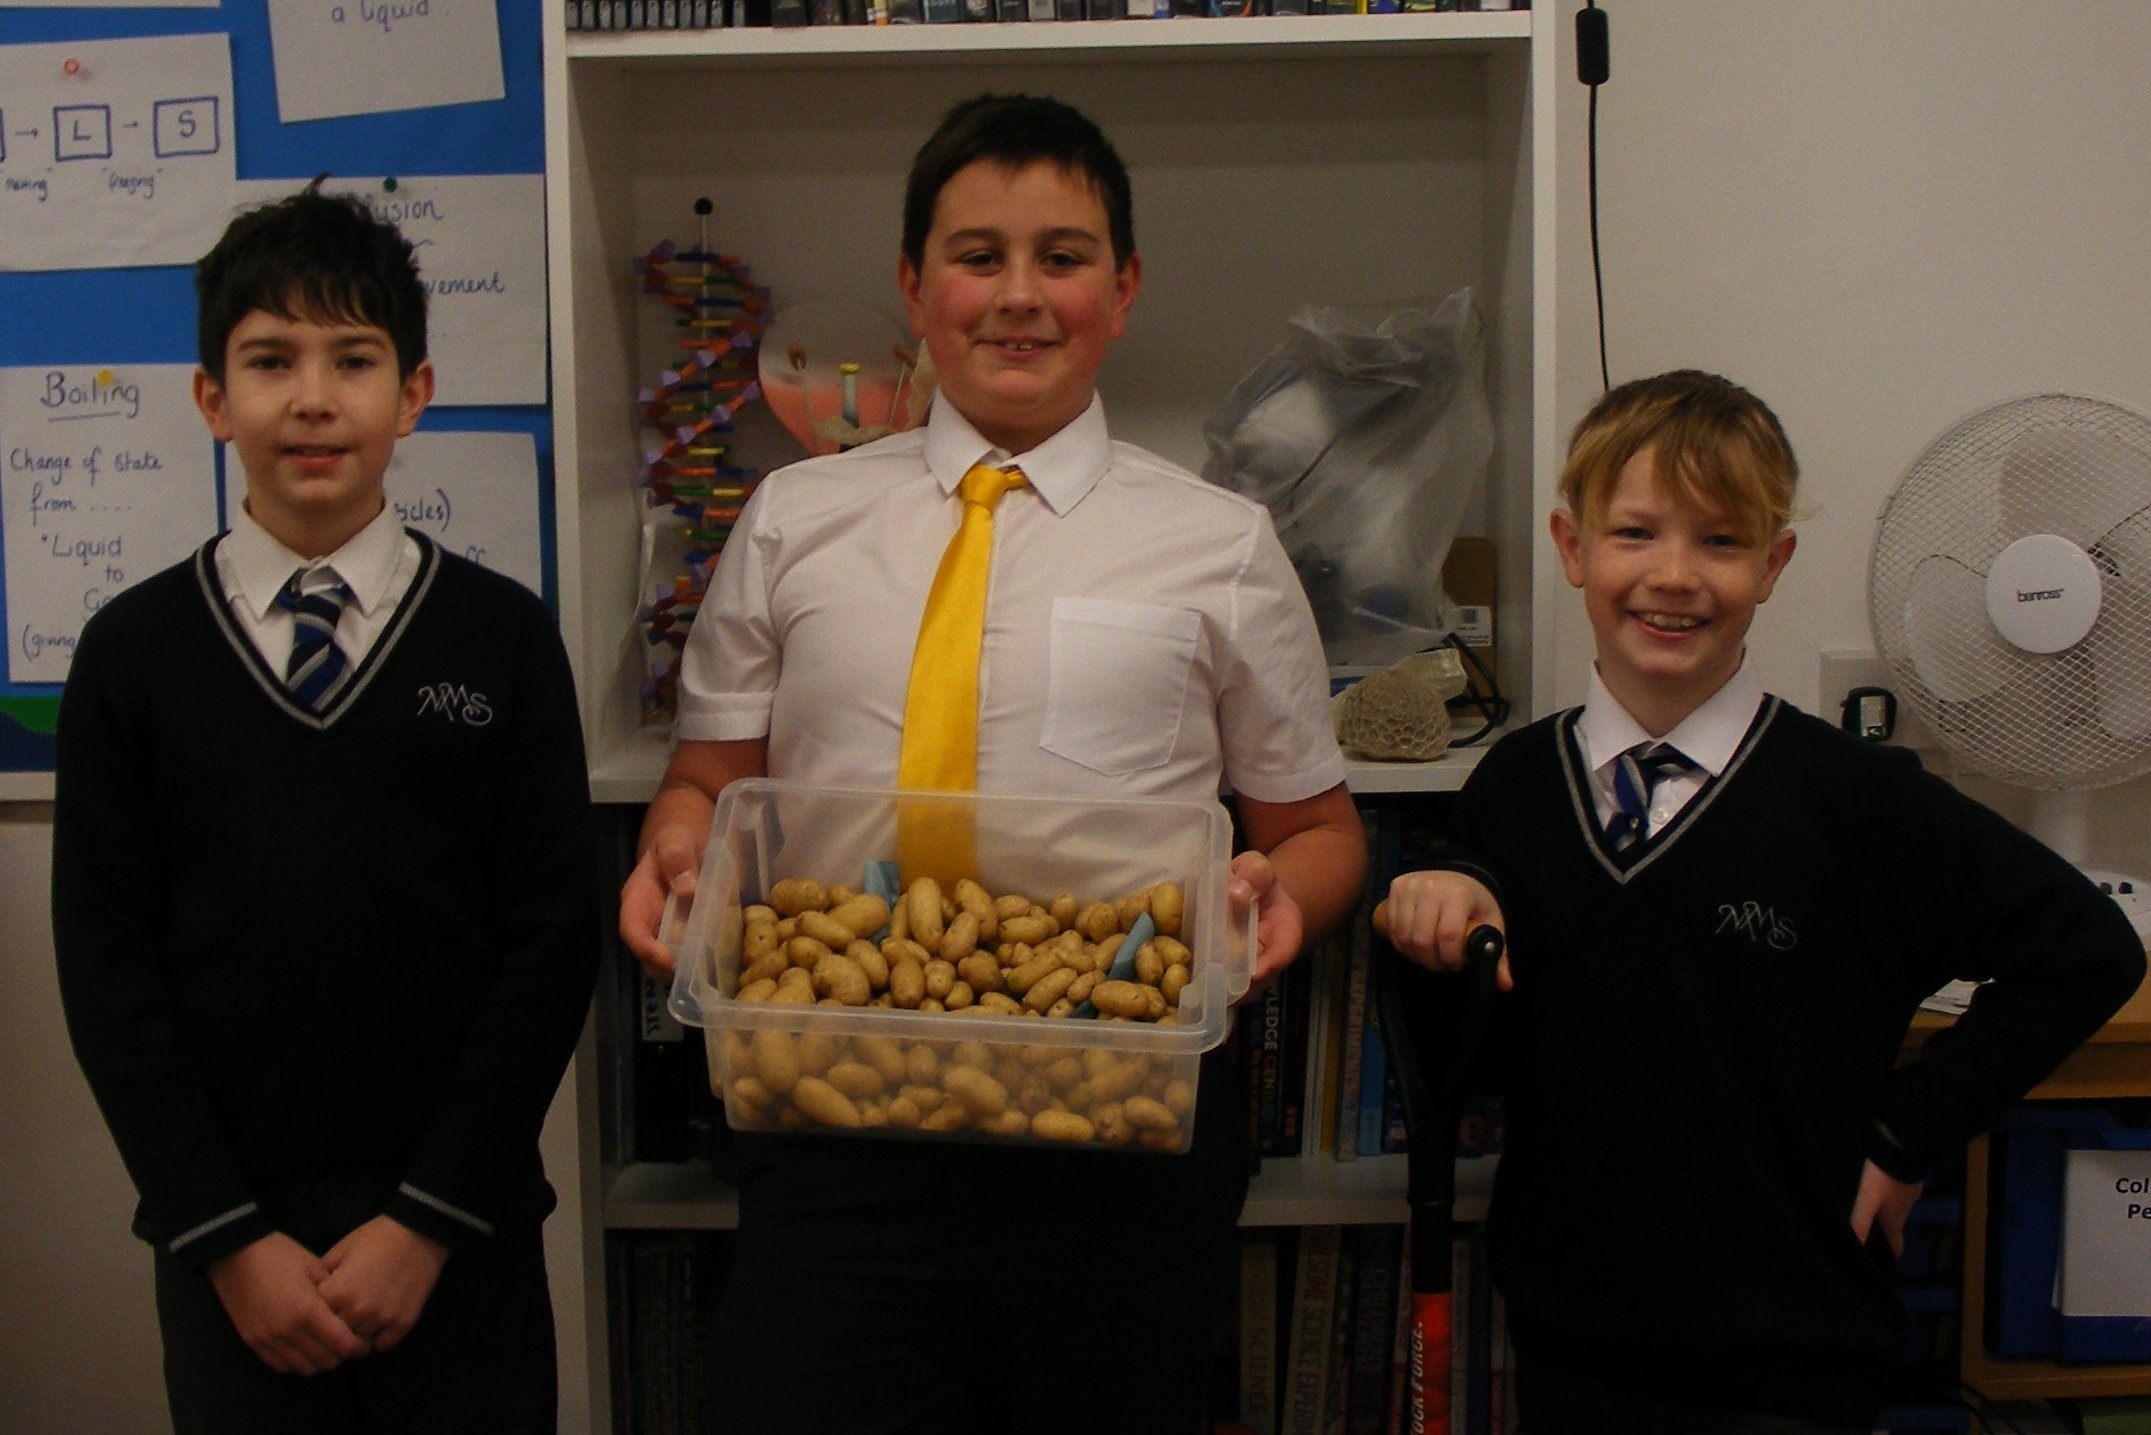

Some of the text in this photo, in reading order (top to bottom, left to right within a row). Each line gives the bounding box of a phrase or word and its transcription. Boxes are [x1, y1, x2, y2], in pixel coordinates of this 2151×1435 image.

[331, 6, 345, 23] a
[72, 108, 197, 142] L S
[421, 271, 505, 296] vement
[40, 370, 140, 419] Boiling
[10, 447, 72, 486] Change
[83, 446, 102, 487] of
[30, 481, 77, 527] from
[104, 565, 124, 583] to
[2115, 1177, 2151, 1194] Col
